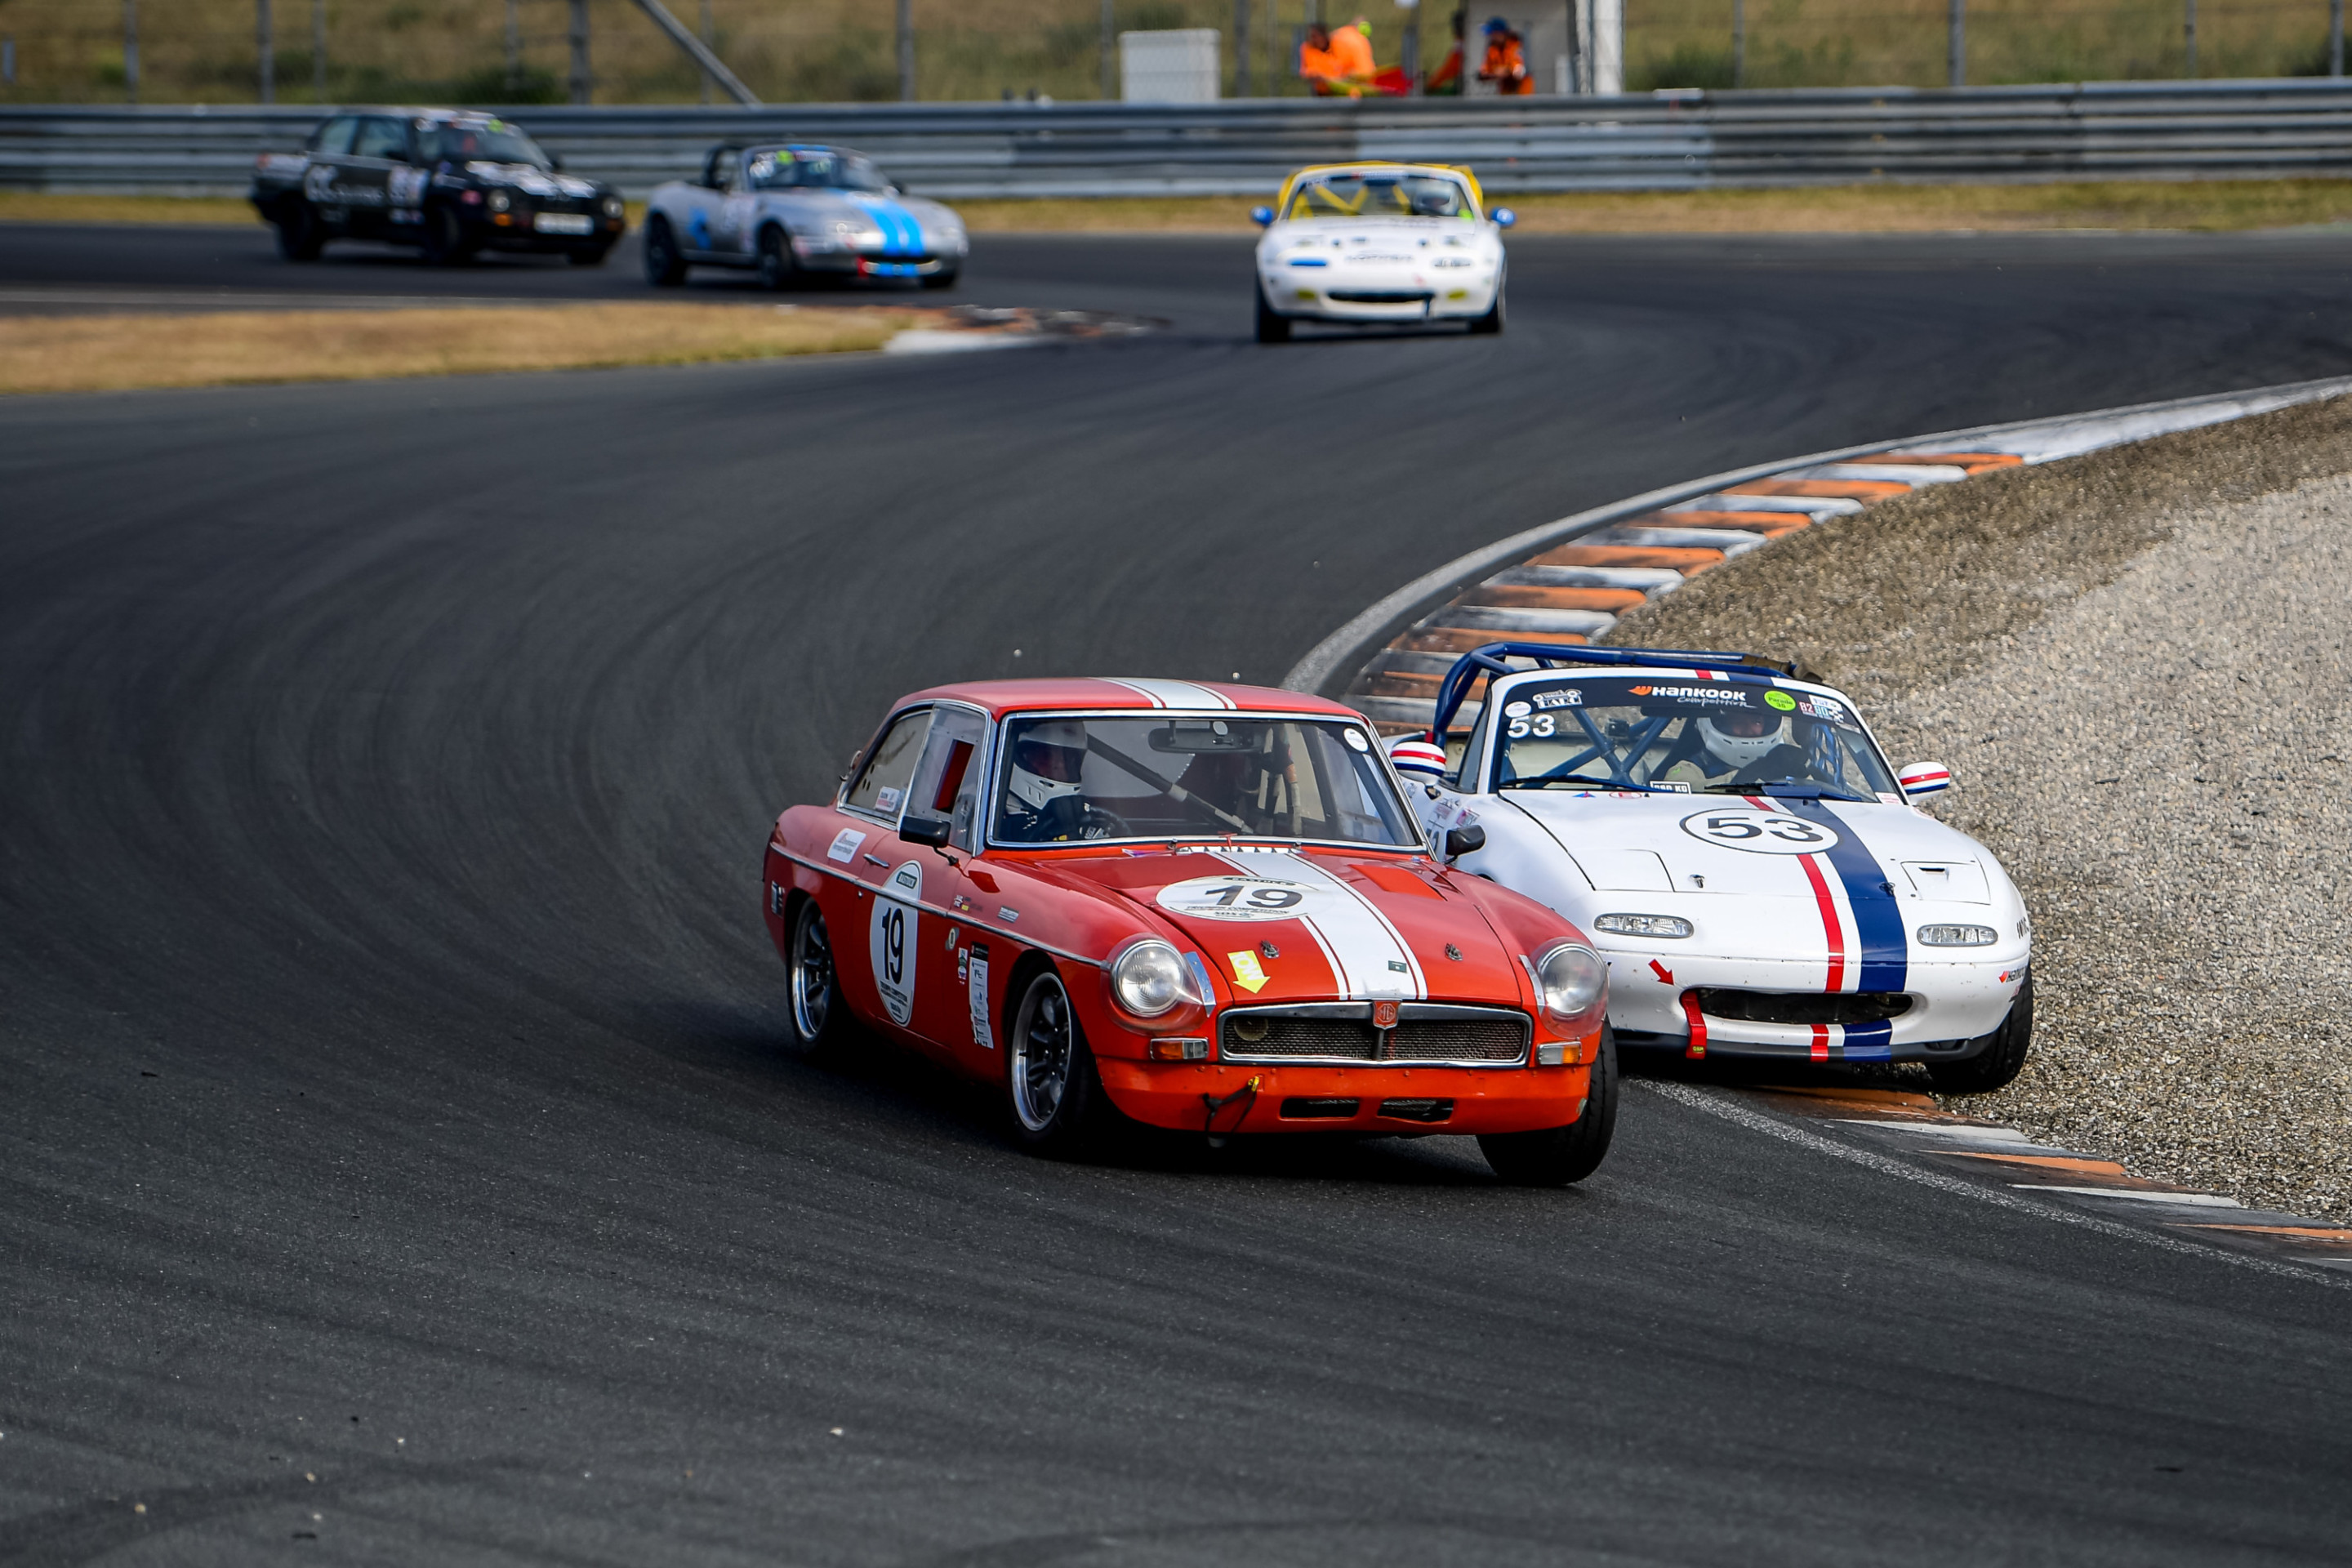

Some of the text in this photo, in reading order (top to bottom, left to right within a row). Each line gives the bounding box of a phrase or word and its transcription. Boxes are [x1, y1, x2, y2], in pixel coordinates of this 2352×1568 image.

[1507, 714, 1555, 739] 53
[1707, 817, 1824, 842] 53
[1205, 884, 1303, 909] 19
[881, 906, 905, 985] 19
[1229, 951, 1265, 981] TOW
